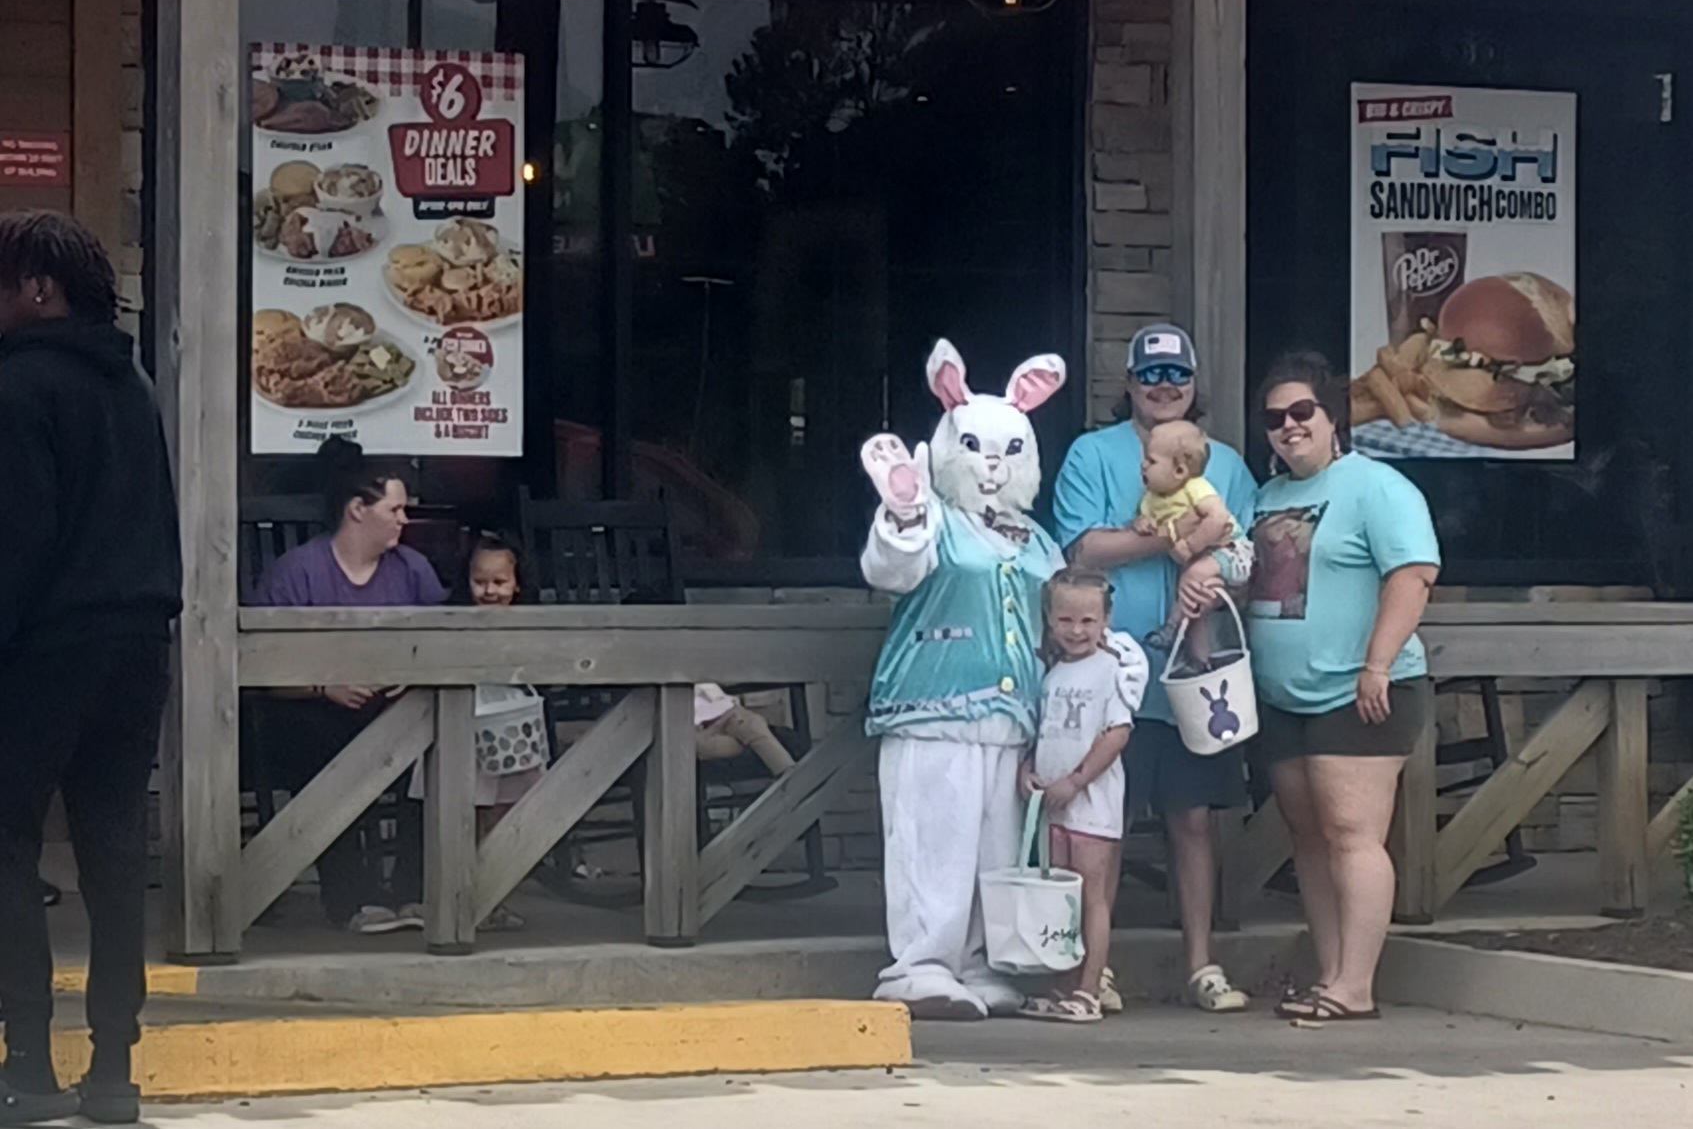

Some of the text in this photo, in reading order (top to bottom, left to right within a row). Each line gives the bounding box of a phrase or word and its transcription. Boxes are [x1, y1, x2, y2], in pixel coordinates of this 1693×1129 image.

[431, 68, 466, 120] $6
[404, 128, 496, 157] DINNER
[1370, 123, 1558, 184] FISH
[424, 157, 477, 186] DEALS
[1370, 180, 1558, 222] SANDWICH COMBO
